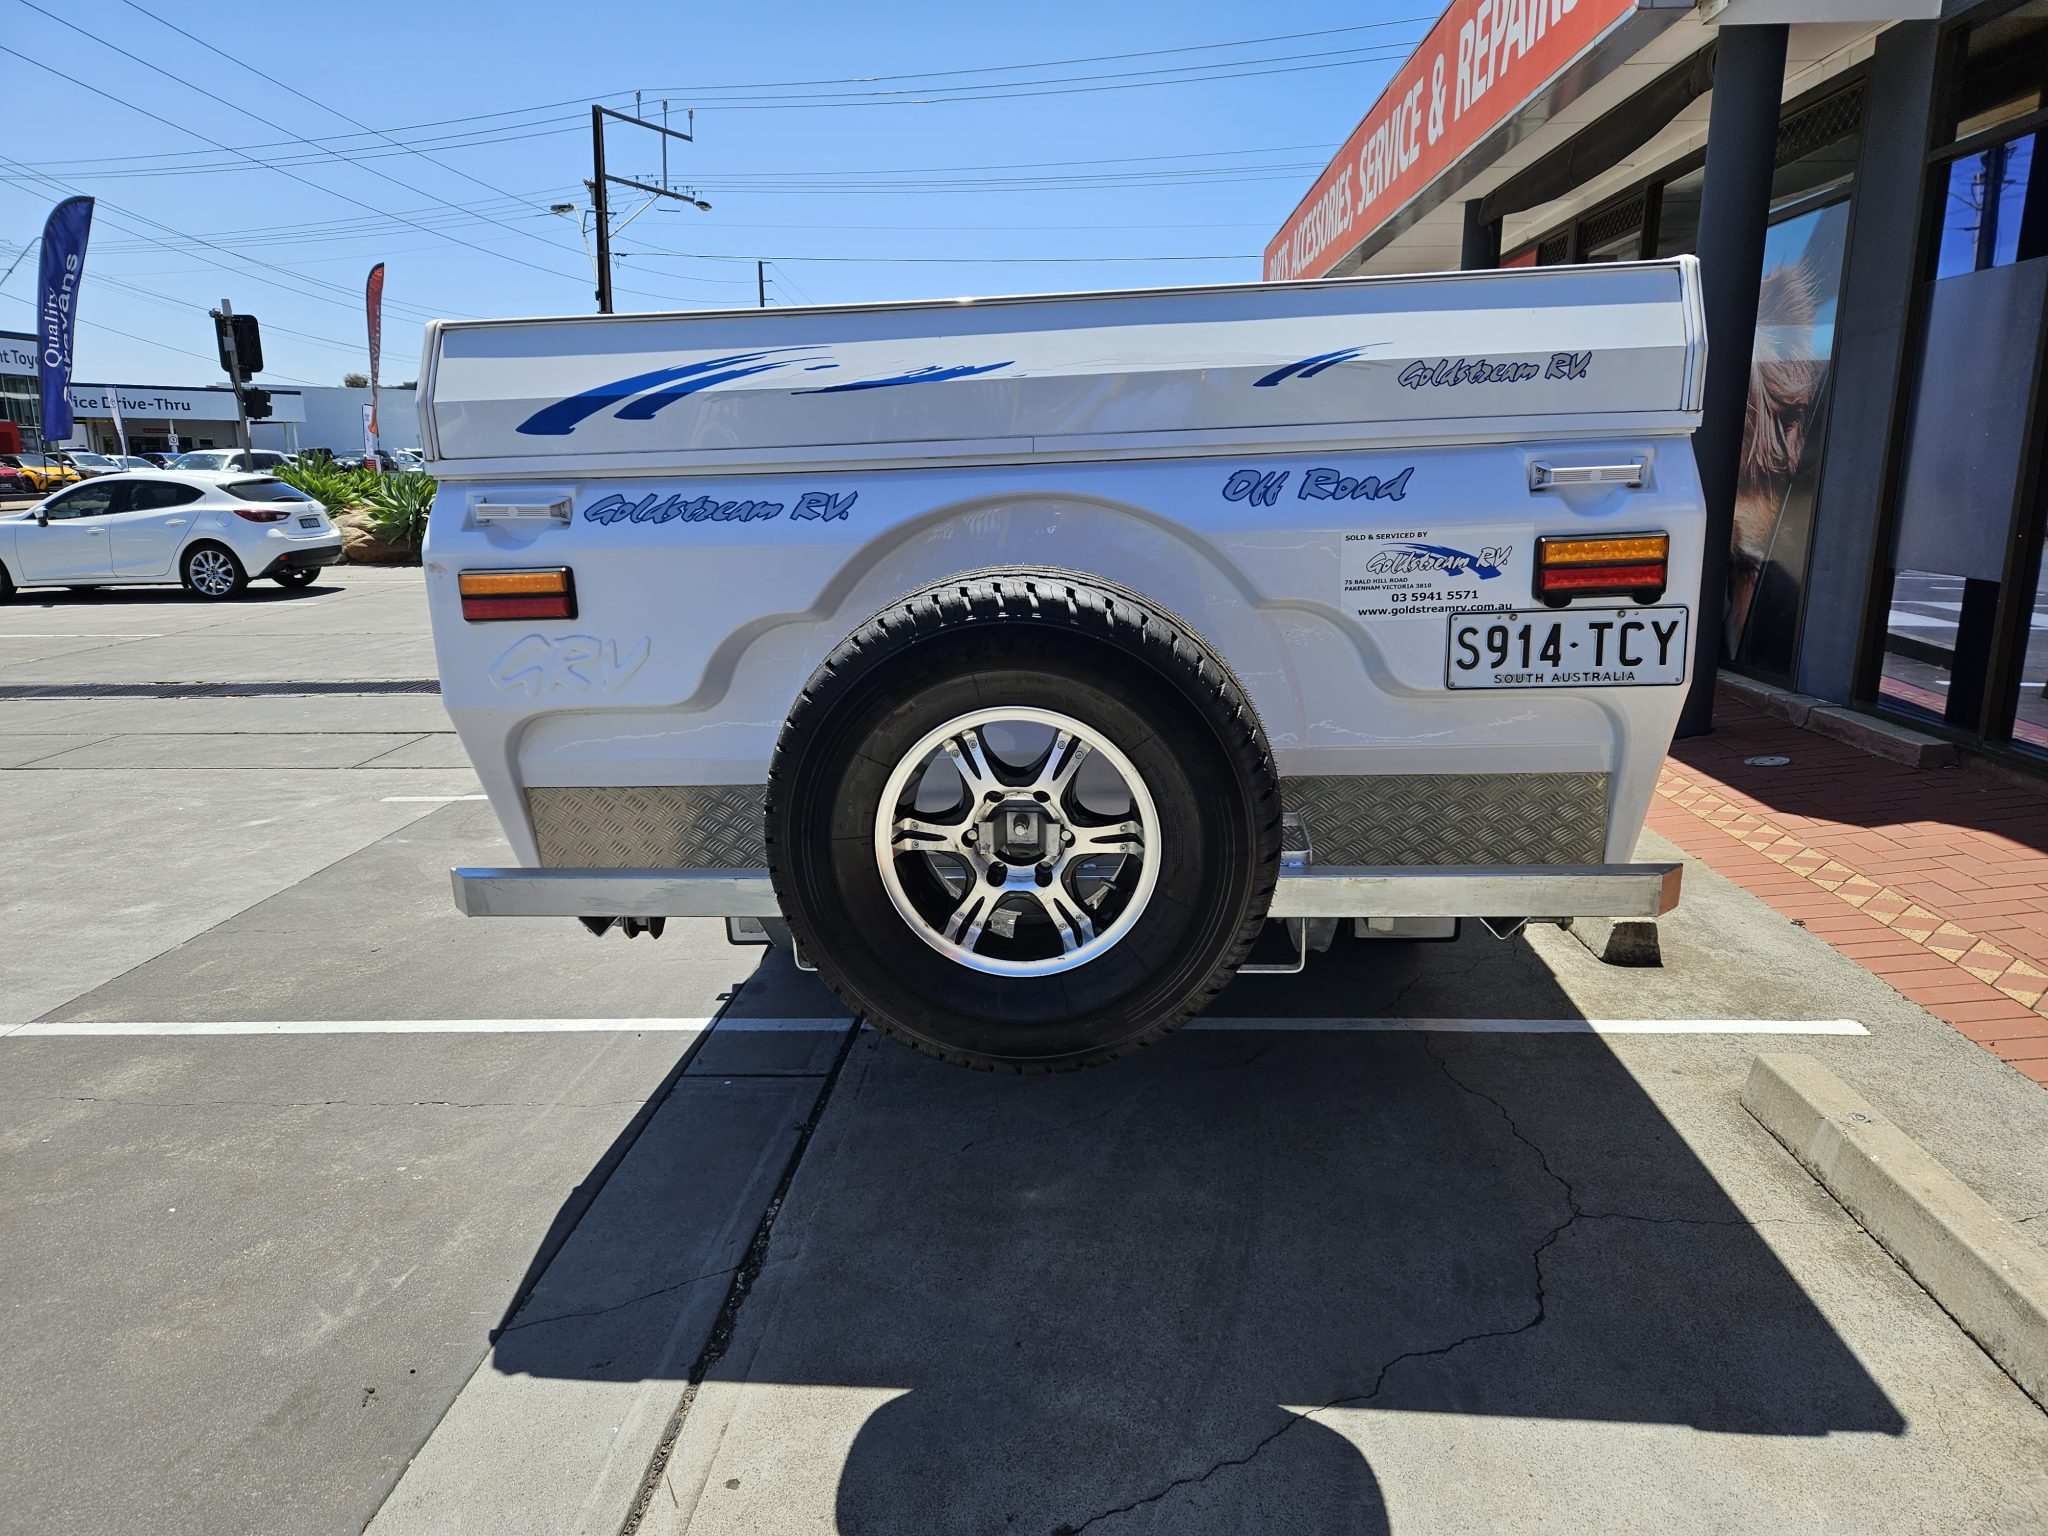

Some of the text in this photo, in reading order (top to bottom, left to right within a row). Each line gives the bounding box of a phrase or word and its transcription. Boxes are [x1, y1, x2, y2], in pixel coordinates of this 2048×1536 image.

[1357, 76, 1424, 216] SERVICE
[1427, 53, 1447, 147] &
[1453, 0, 1578, 123] REPA
[44, 287, 63, 368] Quality
[1397, 358, 1540, 390] Goldstream
[1222, 467, 1415, 507] Off Road
[584, 493, 784, 526] Goldstream
[1376, 532, 1415, 540] SERVICED
[1366, 551, 1470, 575] Goldstream
[1358, 603, 1513, 617] www.goldstreamrv.com.au
[1391, 590, 1479, 602] 03 5941 5571
[1494, 671, 1636, 684] SOUTH AUSTRALIA
